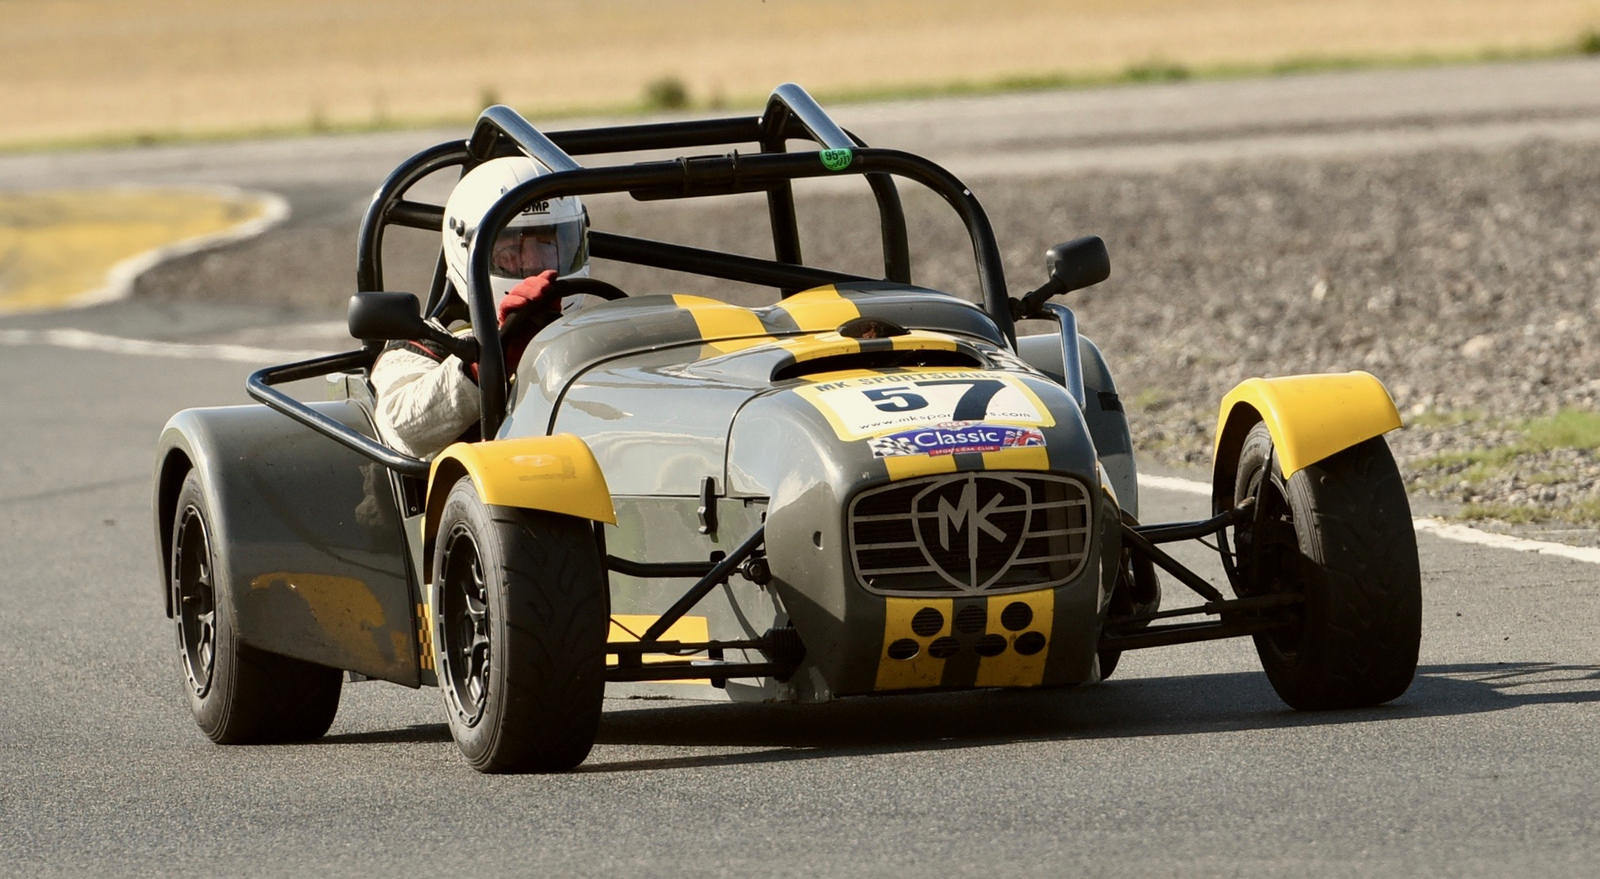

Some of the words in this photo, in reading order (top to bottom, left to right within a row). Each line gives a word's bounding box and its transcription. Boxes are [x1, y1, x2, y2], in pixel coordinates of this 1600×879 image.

[815, 381, 851, 392] MK
[858, 371, 1002, 385] SPORTSCARS
[862, 379, 1006, 421] 57
[914, 429, 1000, 447] Classic
[938, 483, 1008, 559] MK
